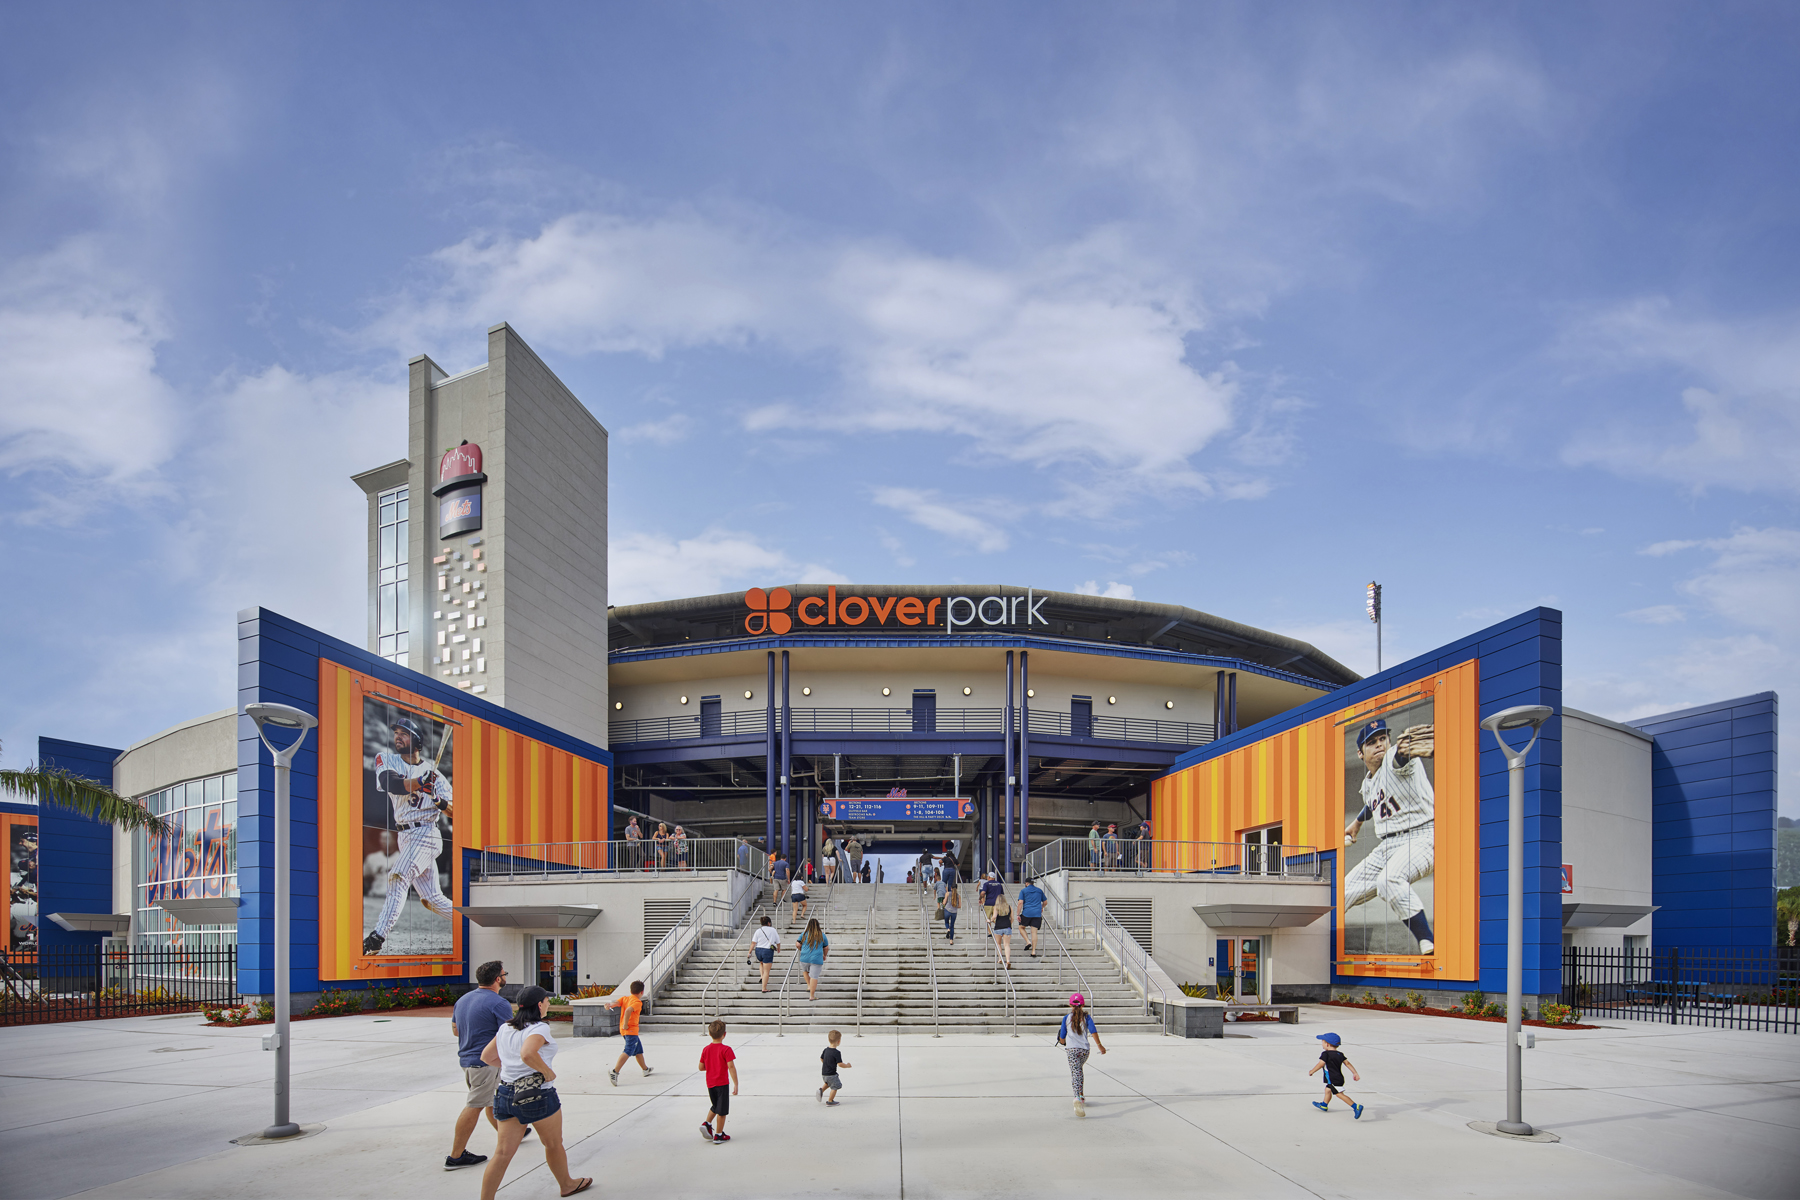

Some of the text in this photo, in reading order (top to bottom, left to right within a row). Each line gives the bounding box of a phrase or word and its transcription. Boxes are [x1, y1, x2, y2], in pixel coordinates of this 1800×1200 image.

[445, 499, 473, 522] Mets
[797, 584, 1049, 634] clover park
[407, 793, 424, 809] 31
[886, 787, 908, 798] Mets
[1380, 795, 1401, 819] 41
[145, 806, 232, 907] Mets
